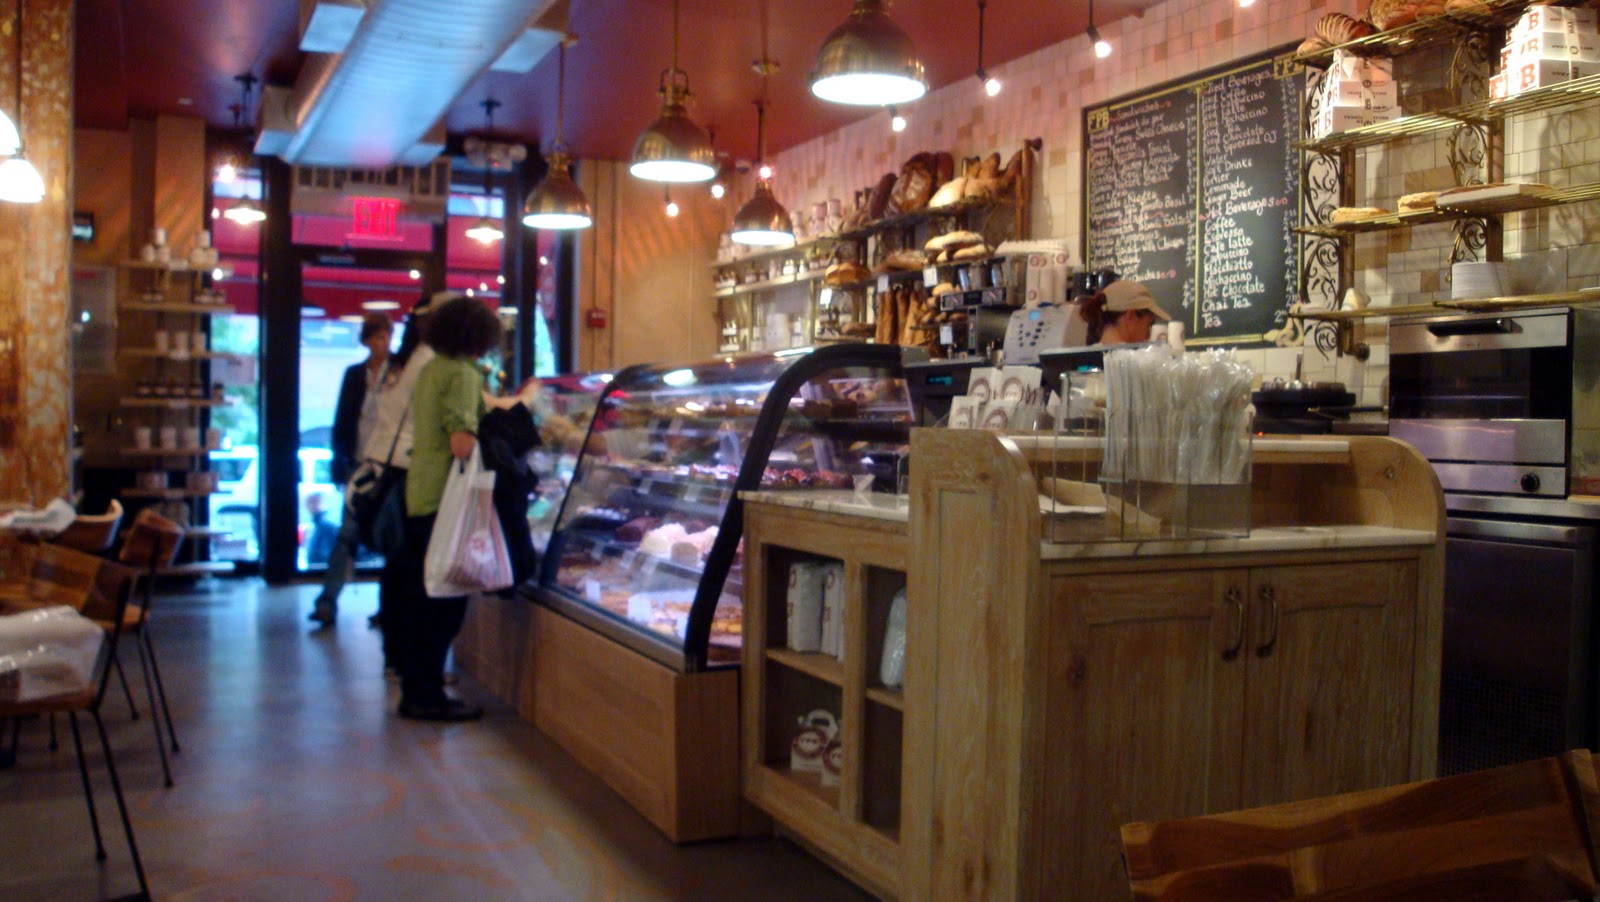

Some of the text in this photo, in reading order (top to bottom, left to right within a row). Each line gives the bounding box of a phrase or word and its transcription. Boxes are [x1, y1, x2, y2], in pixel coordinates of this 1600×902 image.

[1263, 130, 1278, 144] OJ
[1224, 158, 1252, 171] Drinks
[1204, 176, 1246, 195] Lemonade
[1230, 185, 1254, 200] Beer
[1225, 197, 1275, 216] Beverages
[354, 198, 399, 236] EXIT
[1205, 216, 1237, 235] Coffee
[1204, 228, 1244, 245] Espresso
[1222, 275, 1265, 298] Chocolate
[1202, 294, 1252, 312] Chai Tea
[1202, 313, 1222, 328] Tea
